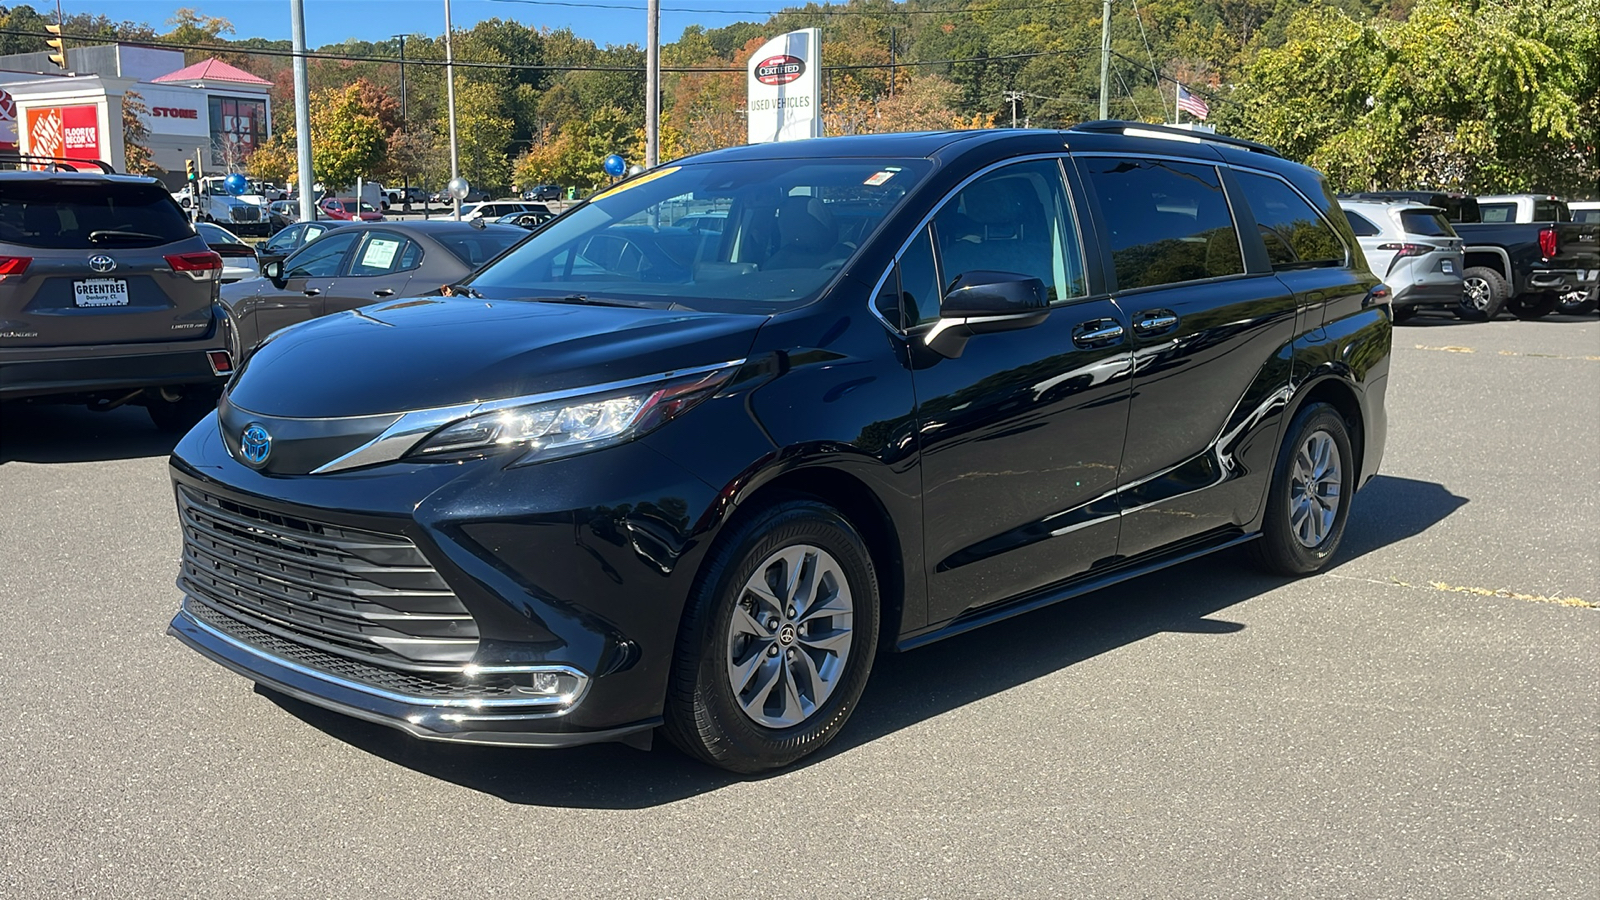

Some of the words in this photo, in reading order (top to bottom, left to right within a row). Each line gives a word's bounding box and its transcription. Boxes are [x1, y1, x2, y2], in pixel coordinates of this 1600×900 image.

[759, 65, 799, 76] CERTIFIED
[751, 99, 769, 111] USED
[772, 96, 809, 109] VEHICLES
[152, 106, 198, 119] STONE
[64, 128, 85, 136] FLOOR
[65, 136, 86, 144] DECOR
[76, 283, 126, 295] GREENTREE
